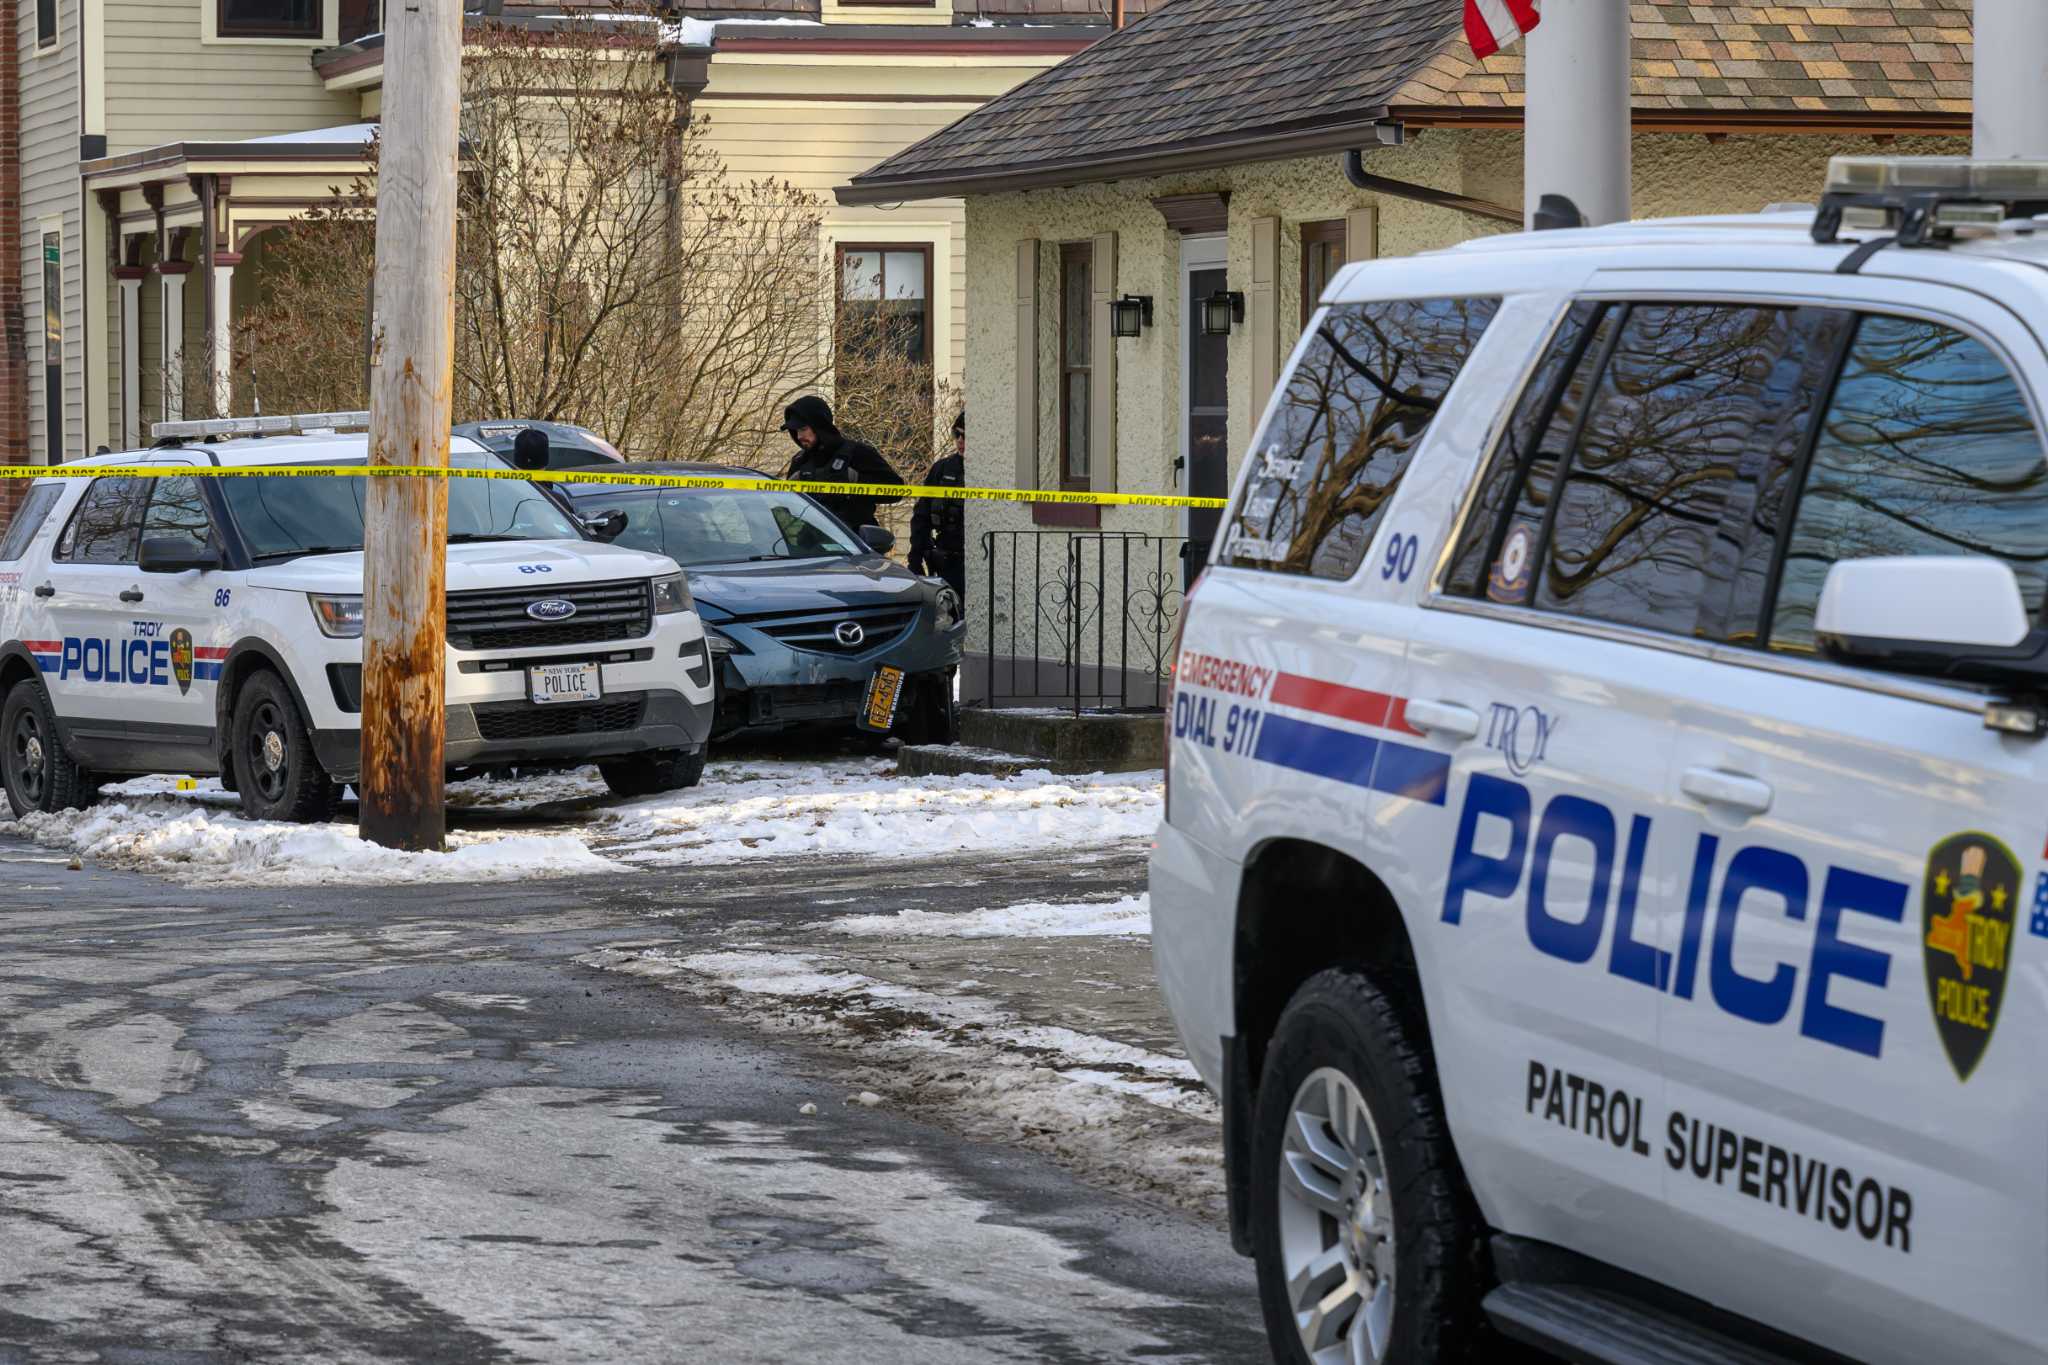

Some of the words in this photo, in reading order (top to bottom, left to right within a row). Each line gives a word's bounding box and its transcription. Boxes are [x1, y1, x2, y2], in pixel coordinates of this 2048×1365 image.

[518, 564, 553, 574] 86
[1381, 532, 1418, 584] 90
[214, 588, 232, 607] 86
[540, 602, 567, 615] Ford
[132, 620, 164, 637] TROY
[60, 637, 170, 686] POLICE
[544, 673, 587, 693] POLICE
[1181, 650, 1273, 699] EMERGENCY
[1175, 691, 1217, 748] DIAL
[1223, 703, 1261, 758] 911
[1484, 703, 1560, 778] TROY
[1440, 771, 1910, 1060] POLICE
[1966, 913, 2010, 971] TROY
[1937, 977, 1991, 1030] POLICE
[1526, 1060, 1650, 1158] PATROL
[1664, 1110, 1913, 1255] SUPERVISOR
